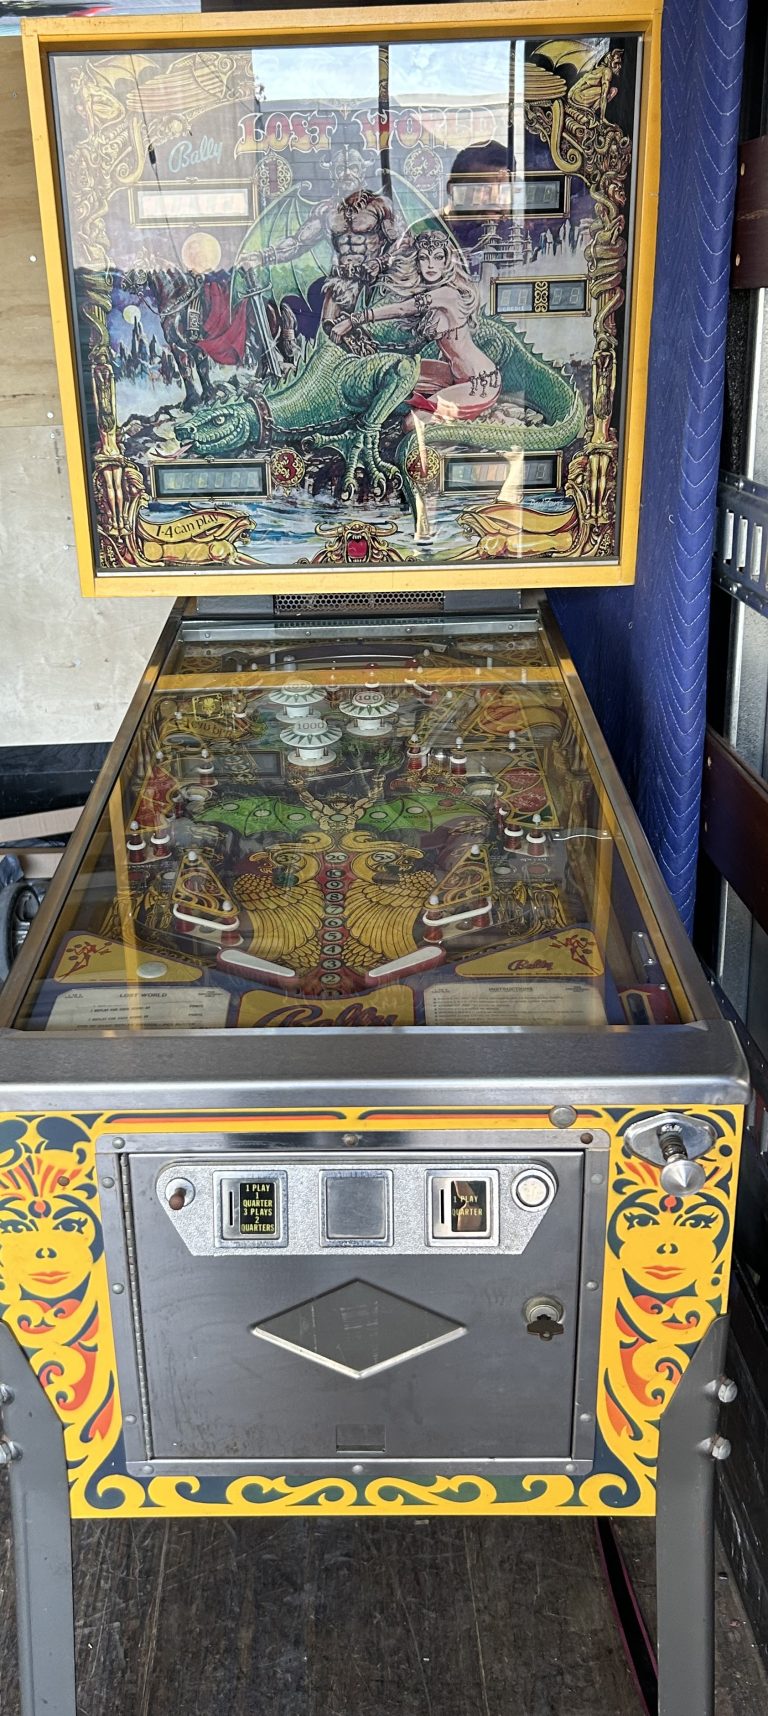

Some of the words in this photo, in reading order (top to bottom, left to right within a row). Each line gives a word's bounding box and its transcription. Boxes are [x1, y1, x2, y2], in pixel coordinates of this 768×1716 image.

[234, 110, 338, 160] LOST
[351, 106, 497, 156] WORLD
[169, 135, 223, 173] Bally
[277, 452, 298, 482] 3
[156, 525, 174, 538] 1-4
[174, 521, 195, 534] can
[197, 513, 219, 528] play
[297, 723, 325, 731] 1000
[331, 881, 339, 889] 9
[331, 892, 339, 900] 8
[329, 919, 338, 927] 6
[328, 932, 337, 940] 5
[326, 945, 336, 953] 4
[327, 960, 336, 968] 3
[508, 959, 554, 971] Bally
[325, 974, 336, 982] 2
[246, 1184, 250, 1192] 1
[252, 1184, 271, 1192] PLAY
[460, 1195, 479, 1203] PLAY
[244, 1208, 248, 1216] 3
[250, 1208, 273, 1216] PLAYS
[452, 1208, 483, 1216] QUARTER
[254, 1216, 260, 1224] 2
[241, 1224, 275, 1232] QUARTERS
